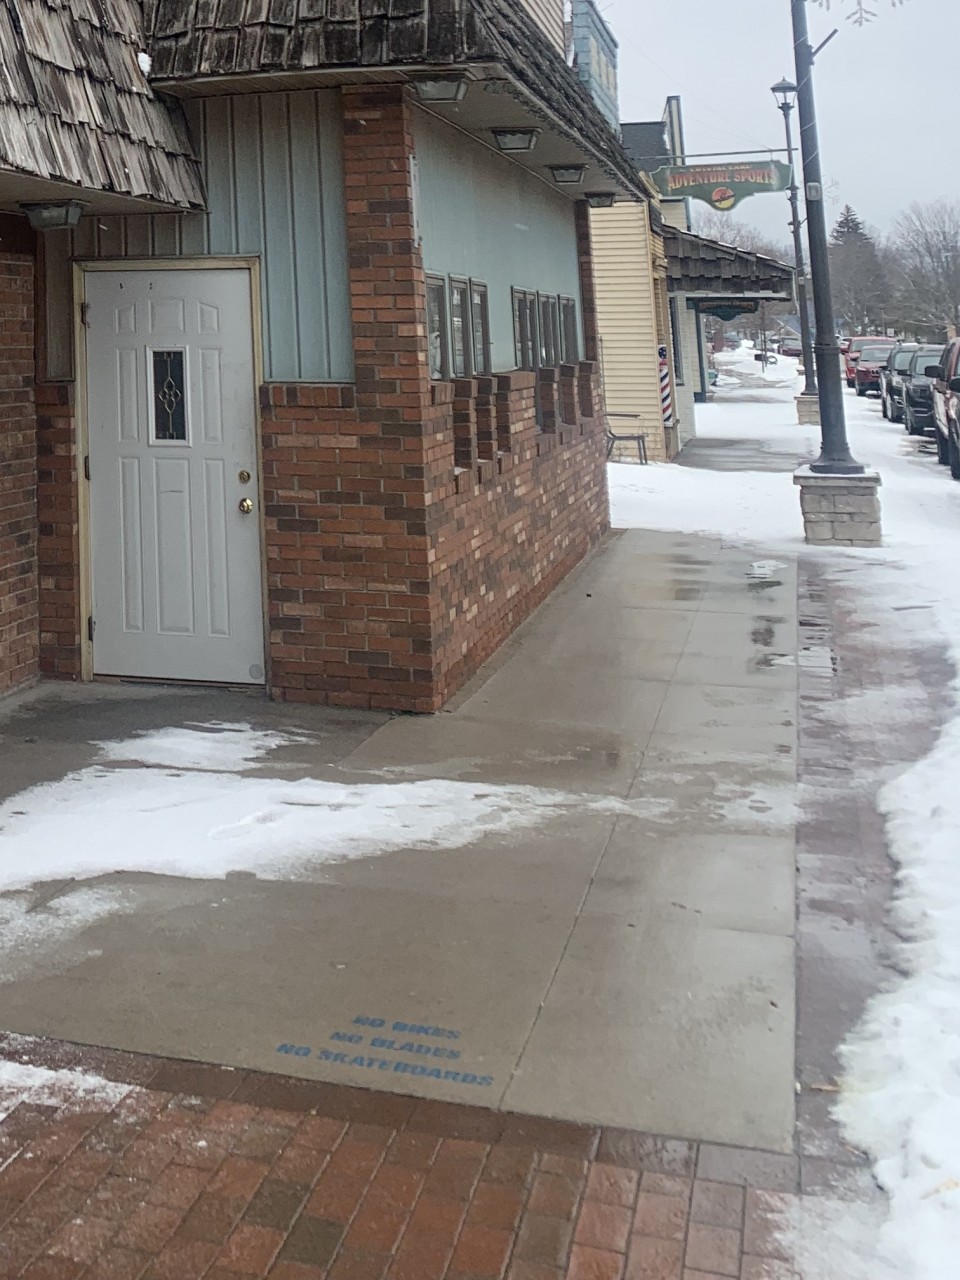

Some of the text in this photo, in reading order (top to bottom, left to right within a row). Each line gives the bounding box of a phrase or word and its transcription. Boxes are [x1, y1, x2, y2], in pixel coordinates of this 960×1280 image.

[668, 168, 777, 190] ADVENTURE SPORTS
[353, 1016, 461, 1039] NO BIKES
[277, 1043, 311, 1057] NO
[330, 1031, 461, 1059] NO BLADES
